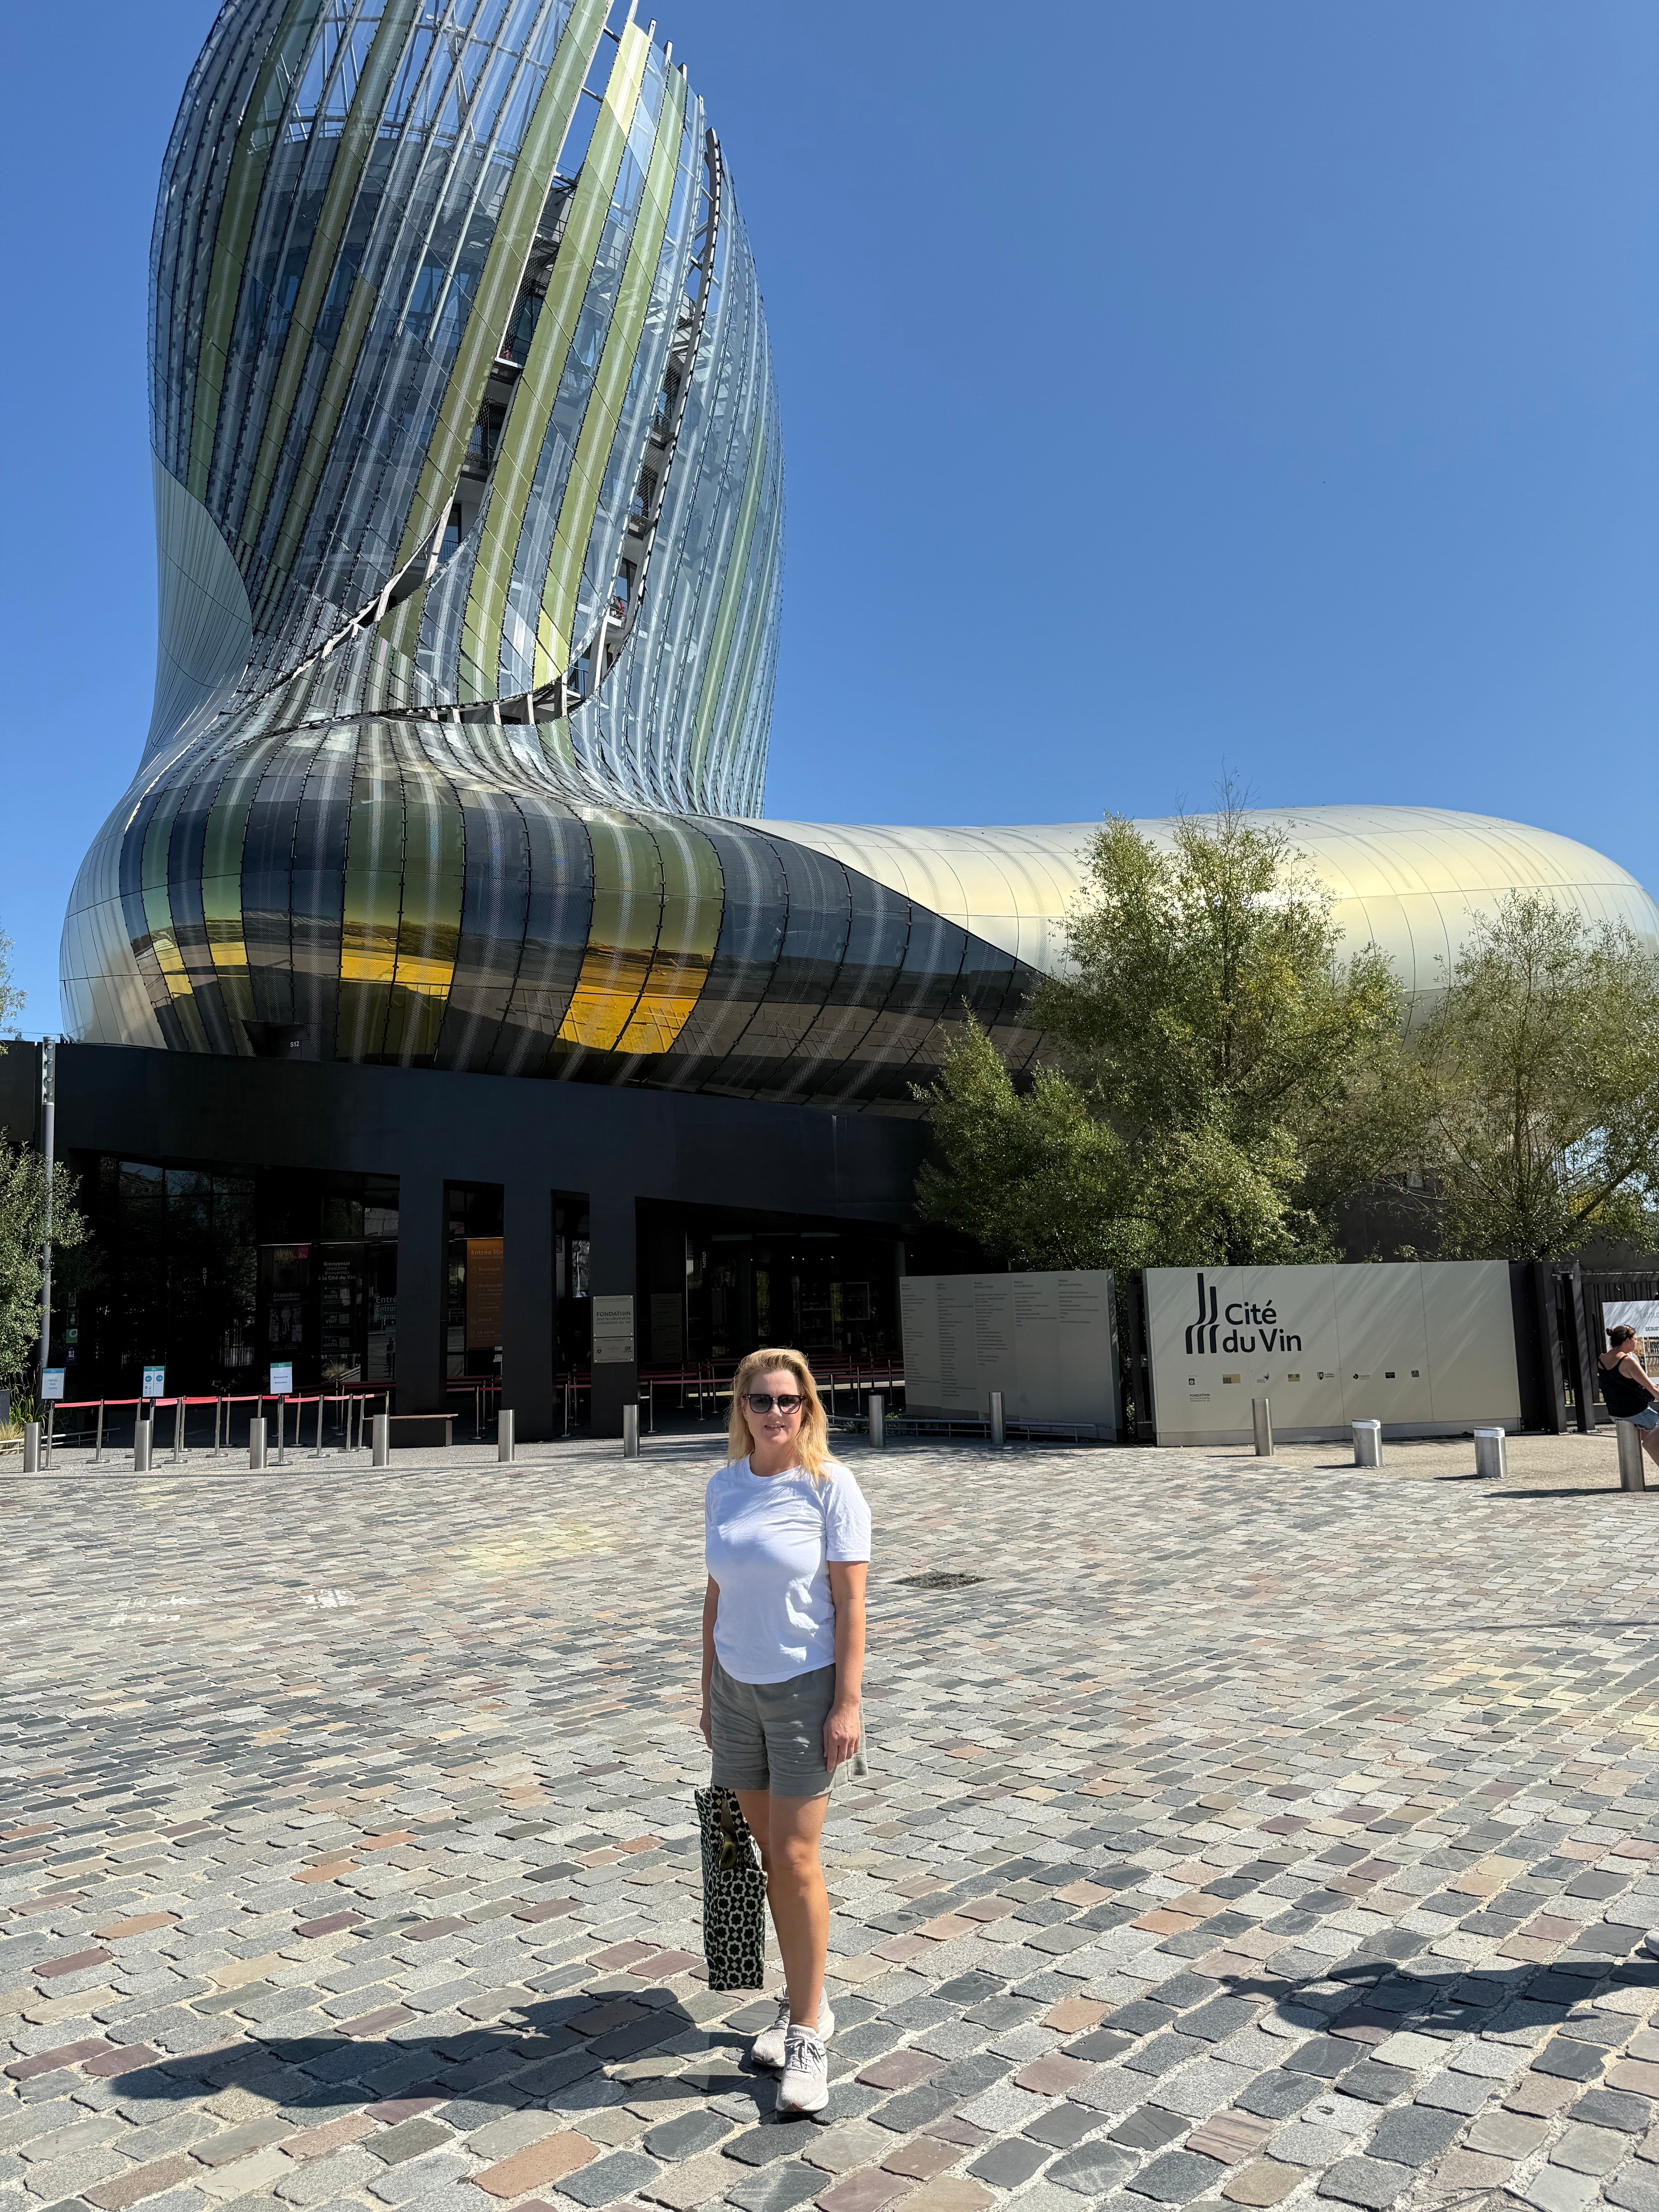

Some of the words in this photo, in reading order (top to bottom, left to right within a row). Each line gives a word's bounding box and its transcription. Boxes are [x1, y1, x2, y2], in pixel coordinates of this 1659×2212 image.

[1225, 1299, 1276, 1325] Cité
[1223, 1329, 1255, 1352] du
[1258, 1328, 1302, 1352] Vin
